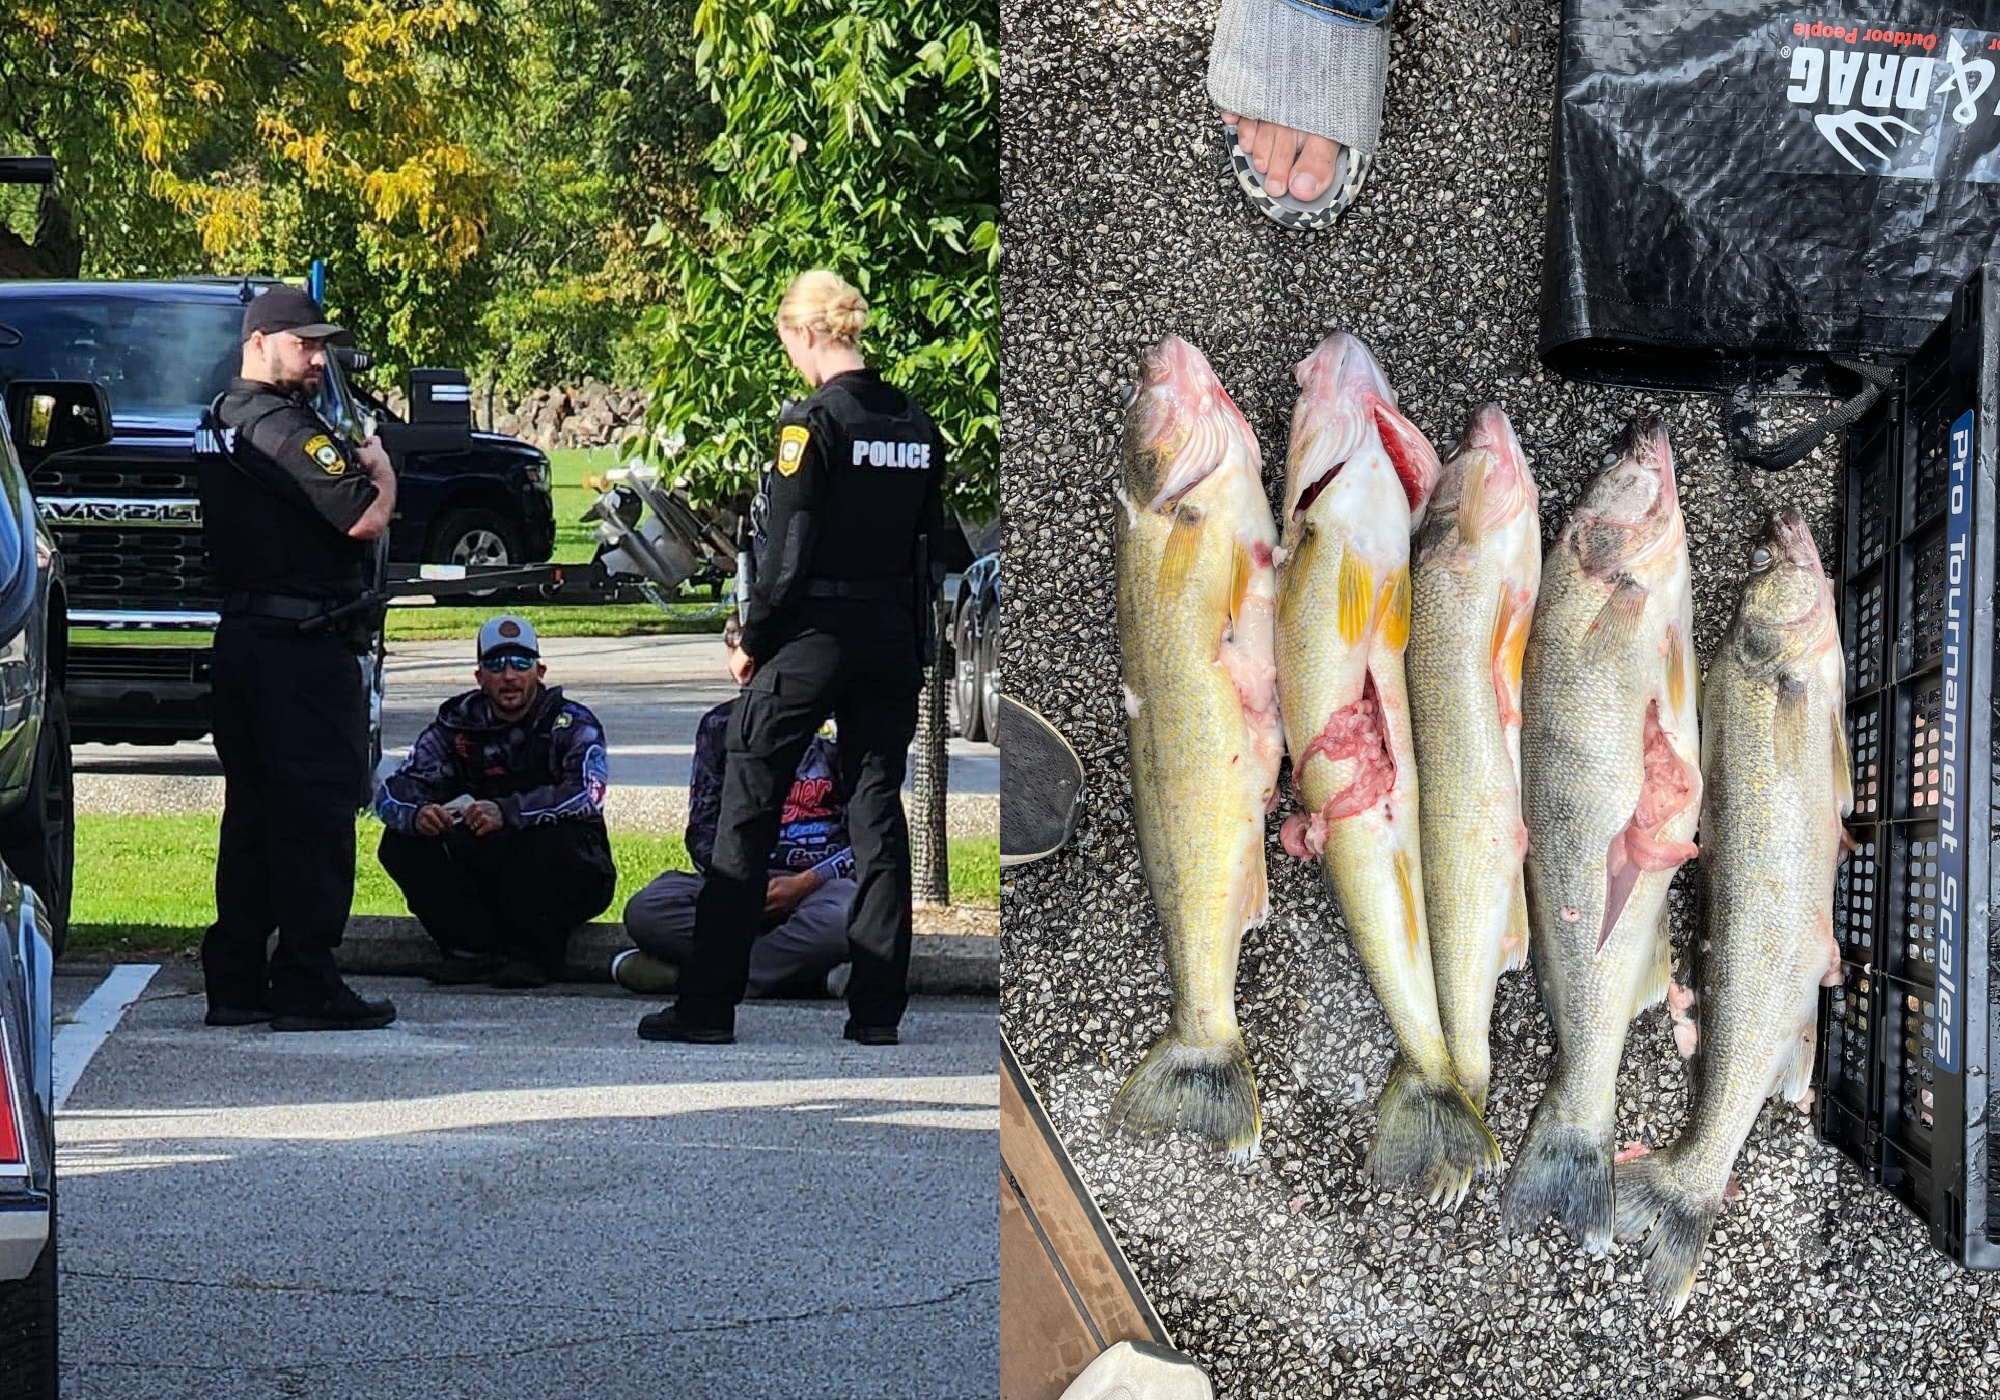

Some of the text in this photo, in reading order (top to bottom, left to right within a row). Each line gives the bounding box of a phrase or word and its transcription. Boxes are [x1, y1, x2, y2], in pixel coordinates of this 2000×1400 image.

[1793, 20, 1858, 44] People
[1863, 29, 1937, 50] Outdoor
[852, 440, 931, 469] POLICE
[1938, 428, 1969, 1066] Pro Tournament Scales
